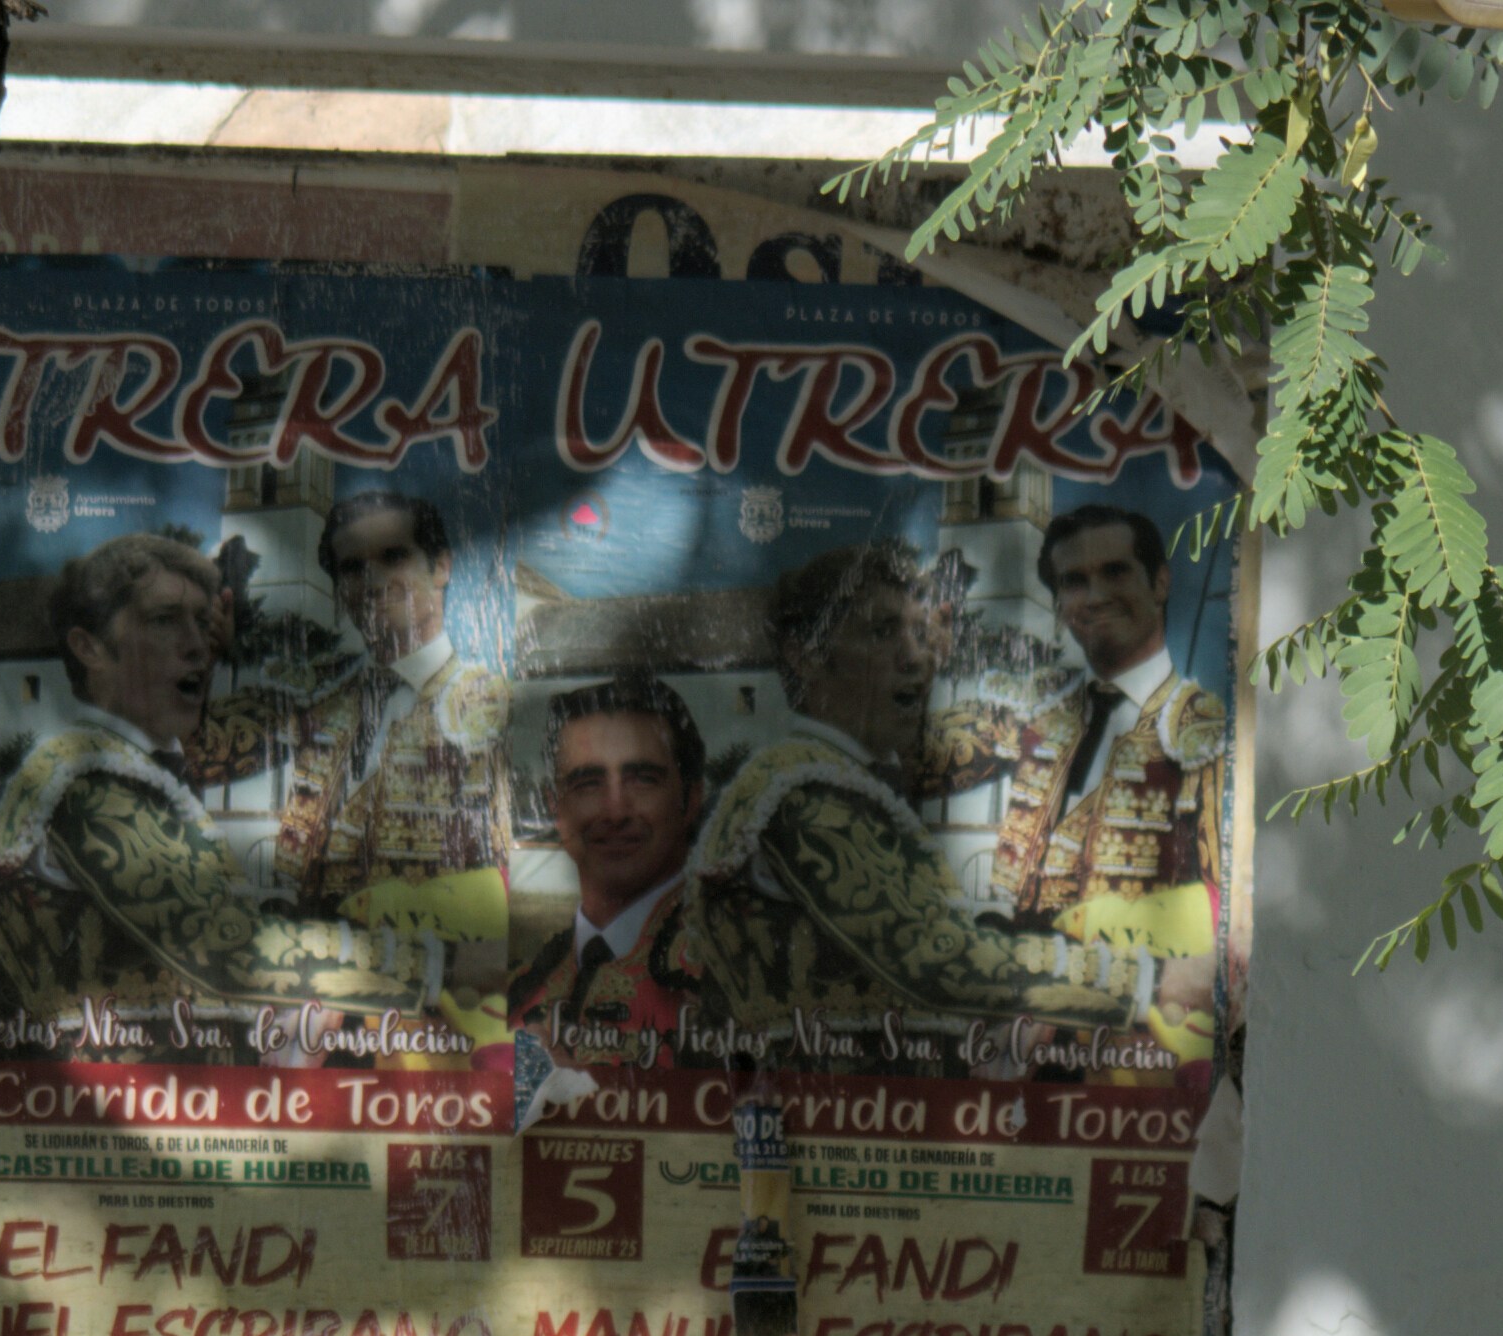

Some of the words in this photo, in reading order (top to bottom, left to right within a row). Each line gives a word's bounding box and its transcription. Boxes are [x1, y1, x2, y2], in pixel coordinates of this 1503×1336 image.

[74, 995, 154, 1048] Ntra.
[170, 999, 232, 1049] Sra.
[248, 1005, 287, 1055] de
[300, 1000, 474, 1057] Consolación
[1008, 1013, 1177, 1071] Consolación
[245, 1076, 313, 1123] de
[337, 1076, 494, 1128] Toros
[954, 1088, 1027, 1136] de
[1047, 1091, 1193, 1144] Toros
[193, 1158, 233, 1181] DE
[244, 1160, 371, 1183] HUEBRA
[539, 1140, 634, 1162] VIERNES
[558, 1165, 617, 1235] 5
[900, 1170, 940, 1192] DE
[950, 1172, 1074, 1197] HUEBRA
[1115, 1195, 1162, 1250] 7
[97, 1220, 317, 1289] FANDI
[803, 1233, 1019, 1302] FANDI
